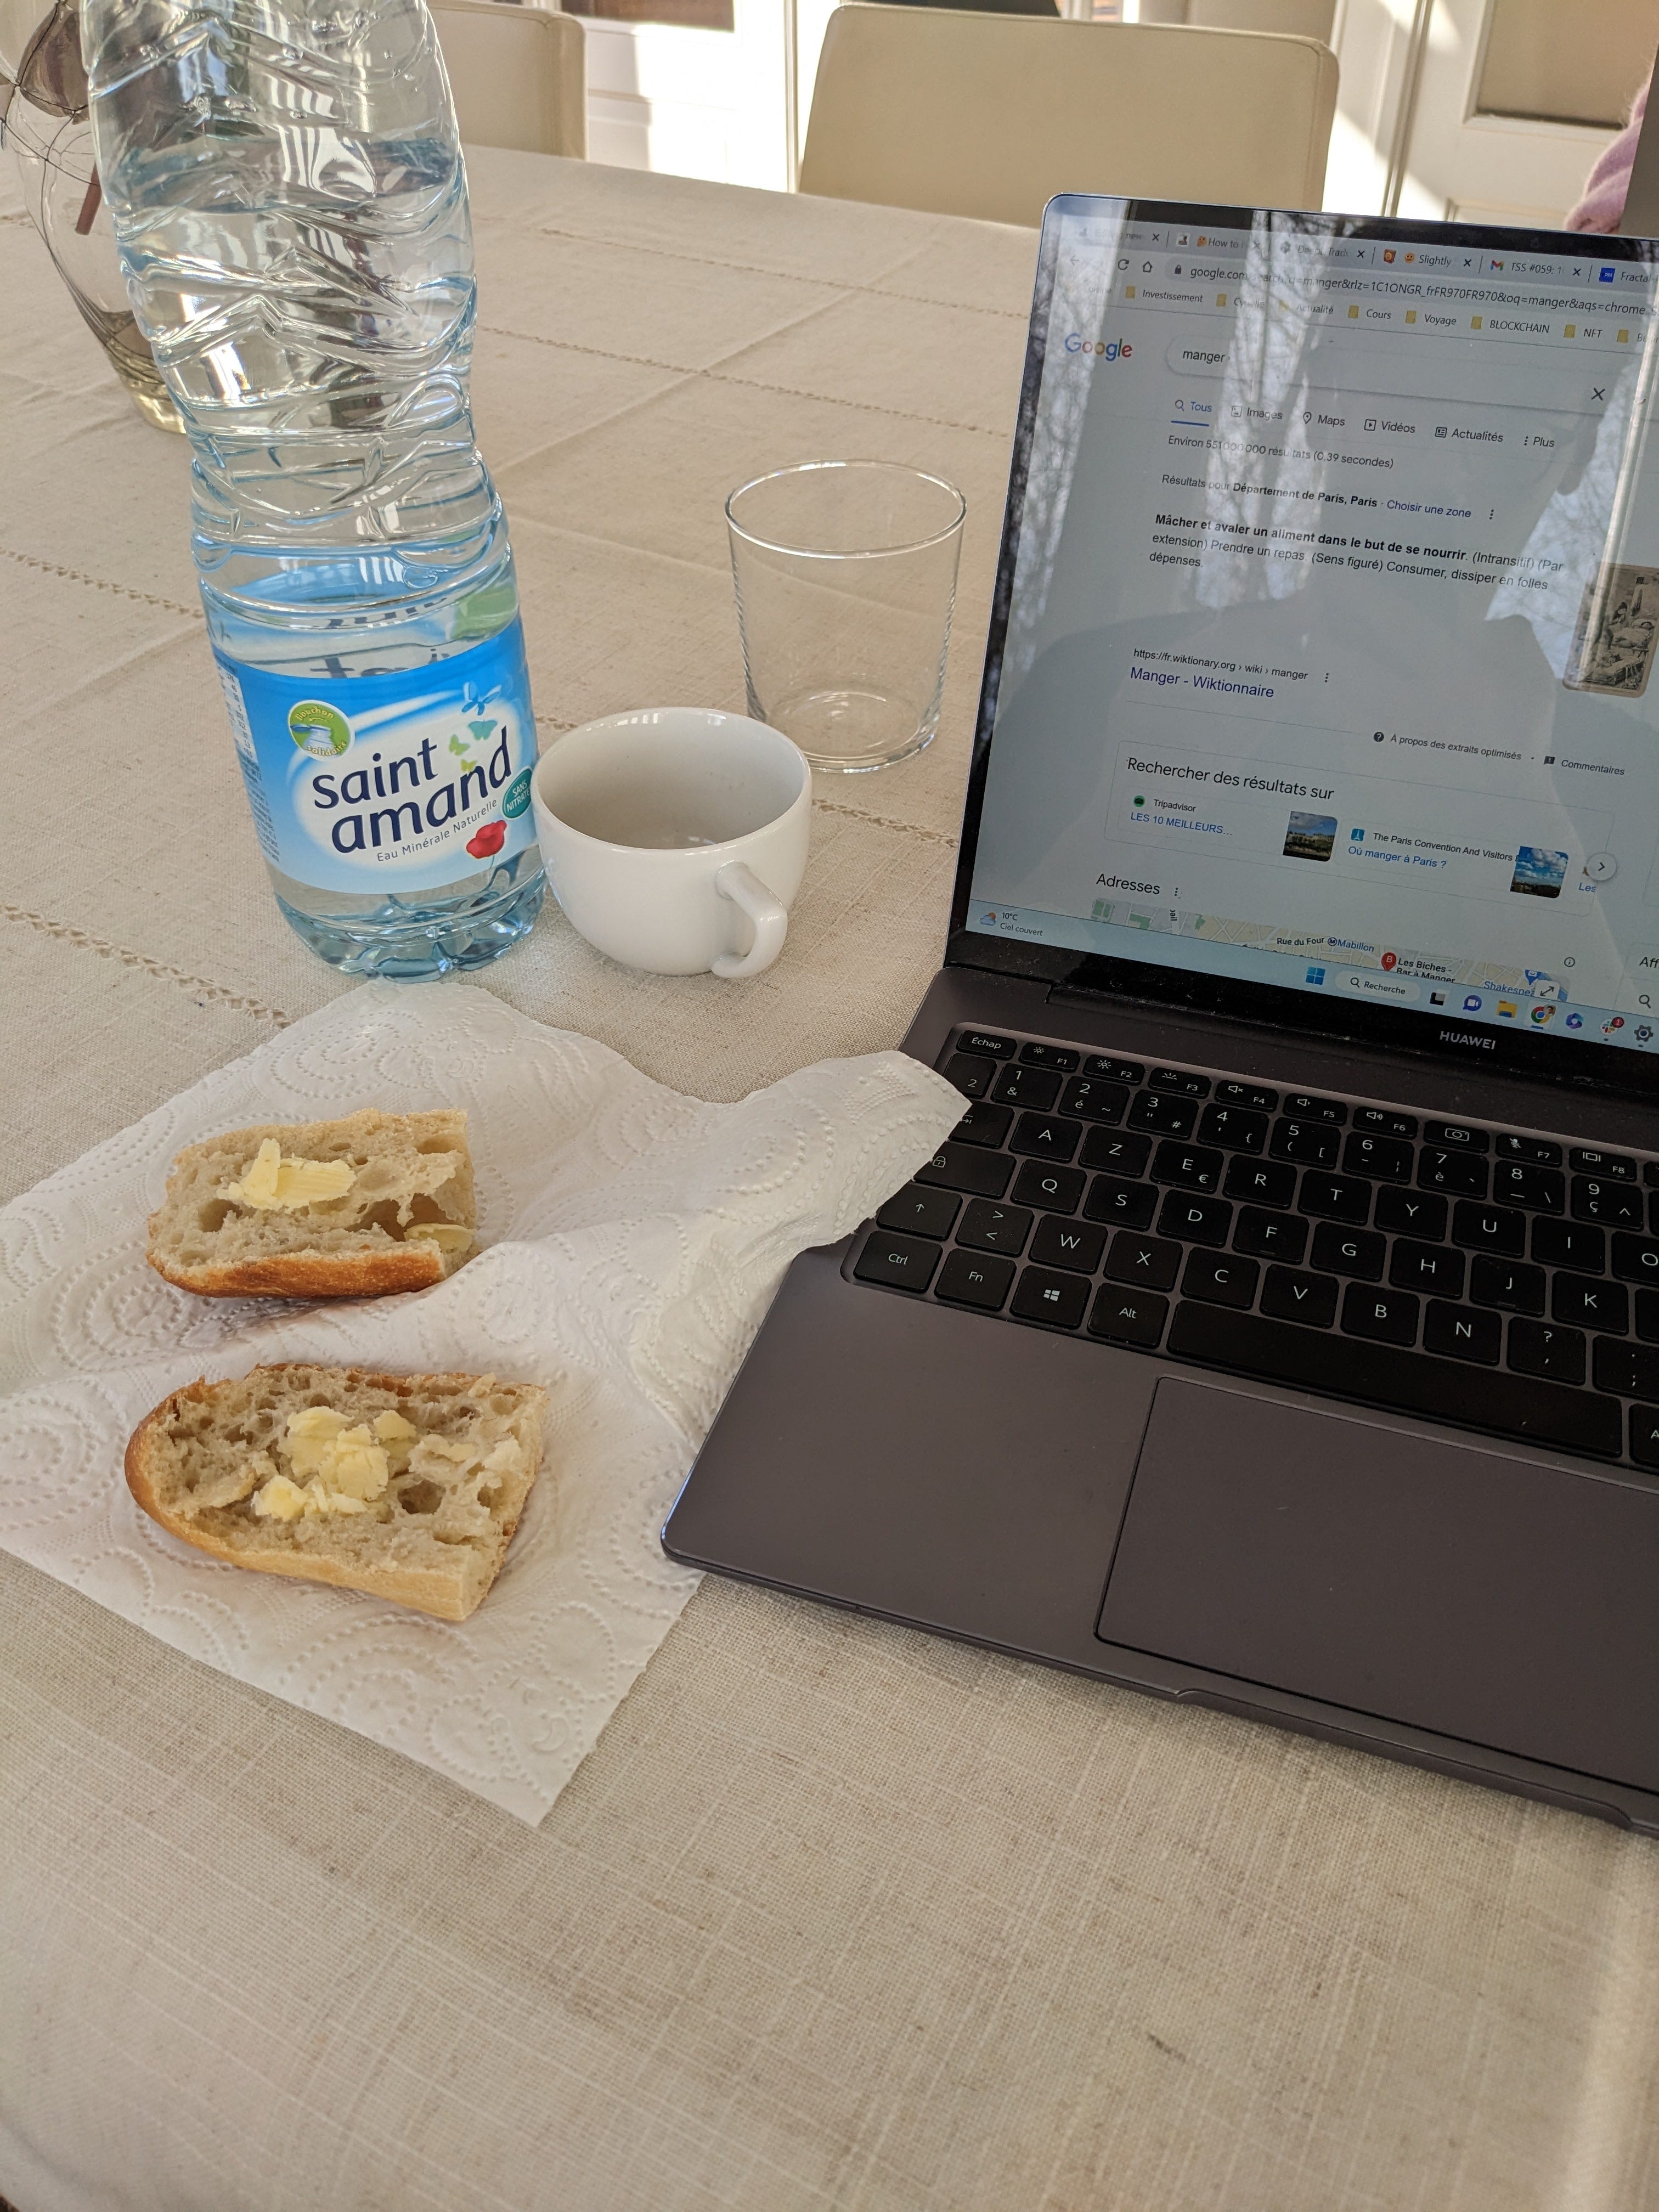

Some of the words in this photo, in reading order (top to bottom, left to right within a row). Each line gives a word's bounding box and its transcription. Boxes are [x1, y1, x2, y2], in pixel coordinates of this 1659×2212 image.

[1209, 238, 1228, 247] How
[1229, 240, 1238, 248] to
[1419, 255, 1451, 267] Slightly
[1511, 262, 1526, 272] TSS
[1530, 263, 1554, 274] #059:
[1143, 289, 1203, 302] Investissement
[1366, 309, 1392, 319] Cours
[1425, 314, 1457, 326] Voyage
[1489, 320, 1549, 334] BLOCKCHAIN
[1583, 329, 1602, 338] NFT
[1064, 333, 1132, 362] Google
[1182, 350, 1225, 364] manger
[1191, 401, 1212, 412] Tous
[1246, 408, 1283, 421] Images
[1318, 415, 1345, 427] Maps
[1381, 421, 1415, 433] Vidéos
[1452, 428, 1503, 442] Actualités
[1533, 437, 1554, 448] Plus
[1168, 436, 1203, 448] Environ
[1268, 447, 1311, 459] résultats
[1341, 454, 1393, 469] secondes)
[1162, 475, 1206, 488] Résultats
[1209, 482, 1230, 491] pour
[1233, 483, 1299, 499] Département
[1302, 490, 1314, 500] de
[1317, 493, 1347, 505] Paris,
[1350, 496, 1378, 507] Paris
[1387, 500, 1422, 513] Choisir
[1425, 505, 1443, 515] une
[1446, 507, 1471, 518] zone
[1155, 515, 1198, 529] Mâcher
[1201, 522, 1211, 530] et
[1215, 523, 1250, 535] avaler
[1254, 528, 1268, 537] un
[1271, 529, 1315, 542] aliment
[1318, 534, 1347, 546] dans
[1350, 538, 1361, 548] le
[1364, 539, 1385, 551] but
[1387, 541, 1402, 552] de
[1406, 545, 1420, 554] se
[1424, 547, 1468, 561] nourrir.
[1472, 551, 1534, 570] (Intransitif)
[1538, 559, 1564, 573] (Par
[1149, 552, 1203, 567] dépenses.
[1152, 534, 1207, 551] extension)
[1211, 540, 1254, 555] Prendre
[1257, 548, 1270, 557] un
[1274, 550, 1307, 561] repas.
[1312, 552, 1344, 566] (Sens
[1347, 557, 1383, 572] figuré)
[1387, 561, 1447, 579] Consumer,
[1451, 568, 1497, 585] dissiper
[1499, 575, 1514, 586] en
[1517, 577, 1548, 590] folles
[1133, 648, 1235, 672] https://fr.wiktionary.org
[1245, 664, 1262, 674] wiki
[1271, 668, 1308, 680] manger
[1130, 667, 1180, 686] Manger
[1193, 675, 1274, 697] Wiktionnaire
[1390, 732, 1397, 743] À
[1399, 736, 1427, 748] propos
[1430, 740, 1446, 749] des
[1448, 743, 1479, 754] extraits
[1481, 747, 1521, 760] optimisés
[312, 738, 437, 809] saint
[1561, 759, 1624, 775] Commentaires
[1127, 757, 1210, 781] Rechercher
[1214, 771, 1240, 786] des
[1243, 776, 1307, 796] résultats
[1311, 787, 1335, 800] sur
[331, 726, 511, 853] amand
[512, 780, 527, 797] SANS
[506, 788, 531, 812] NITRATE
[1154, 799, 1197, 812] Tripadvisor
[1130, 812, 1149, 822] LES
[1153, 816, 1163, 825] 10
[377, 850, 398, 861] Eau
[402, 830, 450, 856] Minérale
[453, 799, 498, 833] Naturelle
[1373, 833, 1389, 841] The
[1391, 836, 1412, 845] Paris
[1415, 839, 1461, 853] Convention
[1463, 847, 1480, 856] And
[1483, 850, 1513, 861] Visitors
[1348, 846, 1362, 855] Où
[1365, 849, 1402, 862] manger
[1404, 855, 1409, 863] à
[1413, 856, 1437, 867] Paris
[1441, 860, 1446, 868] ?
[1096, 873, 1160, 895] Adresses
[1578, 882, 1596, 892] Les
[1001, 912, 1018, 922] 10°C
[1000, 922, 1014, 932] Ciel
[1015, 926, 1042, 936] couvert
[1337, 939, 1374, 952] Mabillon
[1396, 967, 1412, 975] Bar
[1398, 958, 1414, 967] Les
[1416, 961, 1446, 973] Biches
[1364, 981, 1406, 995] Recherche
[972, 1037, 1001, 1049] Échap
[1440, 1030, 1496, 1049] HUAWEI
[1016, 1070, 1022, 1080] 1
[1079, 1084, 1090, 1093] 2
[1217, 1111, 1228, 1121] 4
[1039, 1130, 1051, 1141] A
[1109, 1143, 1122, 1155] Z
[1182, 1159, 1193, 1171] E
[1613, 1166, 1624, 1174] F8
[1042, 1179, 1057, 1193] Q
[1255, 1173, 1267, 1186] R
[1330, 1189, 1342, 1201] T
[1588, 1184, 1599, 1195] 9
[1116, 1195, 1127, 1206] S
[1188, 1210, 1202, 1222] D
[1406, 1204, 1419, 1217] Y
[1266, 1227, 1277, 1238] F
[1483, 1219, 1497, 1233] U
[1060, 1234, 1080, 1250] W
[1567, 1237, 1571, 1248] I
[1342, 1244, 1357, 1256] G
[888, 1254, 908, 1266] Ctrl
[1137, 1251, 1151, 1266] X
[1641, 1254, 1658, 1266] O
[1421, 1259, 1436, 1273] H
[969, 1271, 983, 1282] Fn
[1215, 1269, 1228, 1283] C
[1506, 1277, 1513, 1289] J
[1294, 1285, 1308, 1300] V
[1585, 1293, 1598, 1308] K
[1119, 1307, 1137, 1319] Alt
[1375, 1305, 1387, 1318] B
[1456, 1322, 1471, 1338] N
